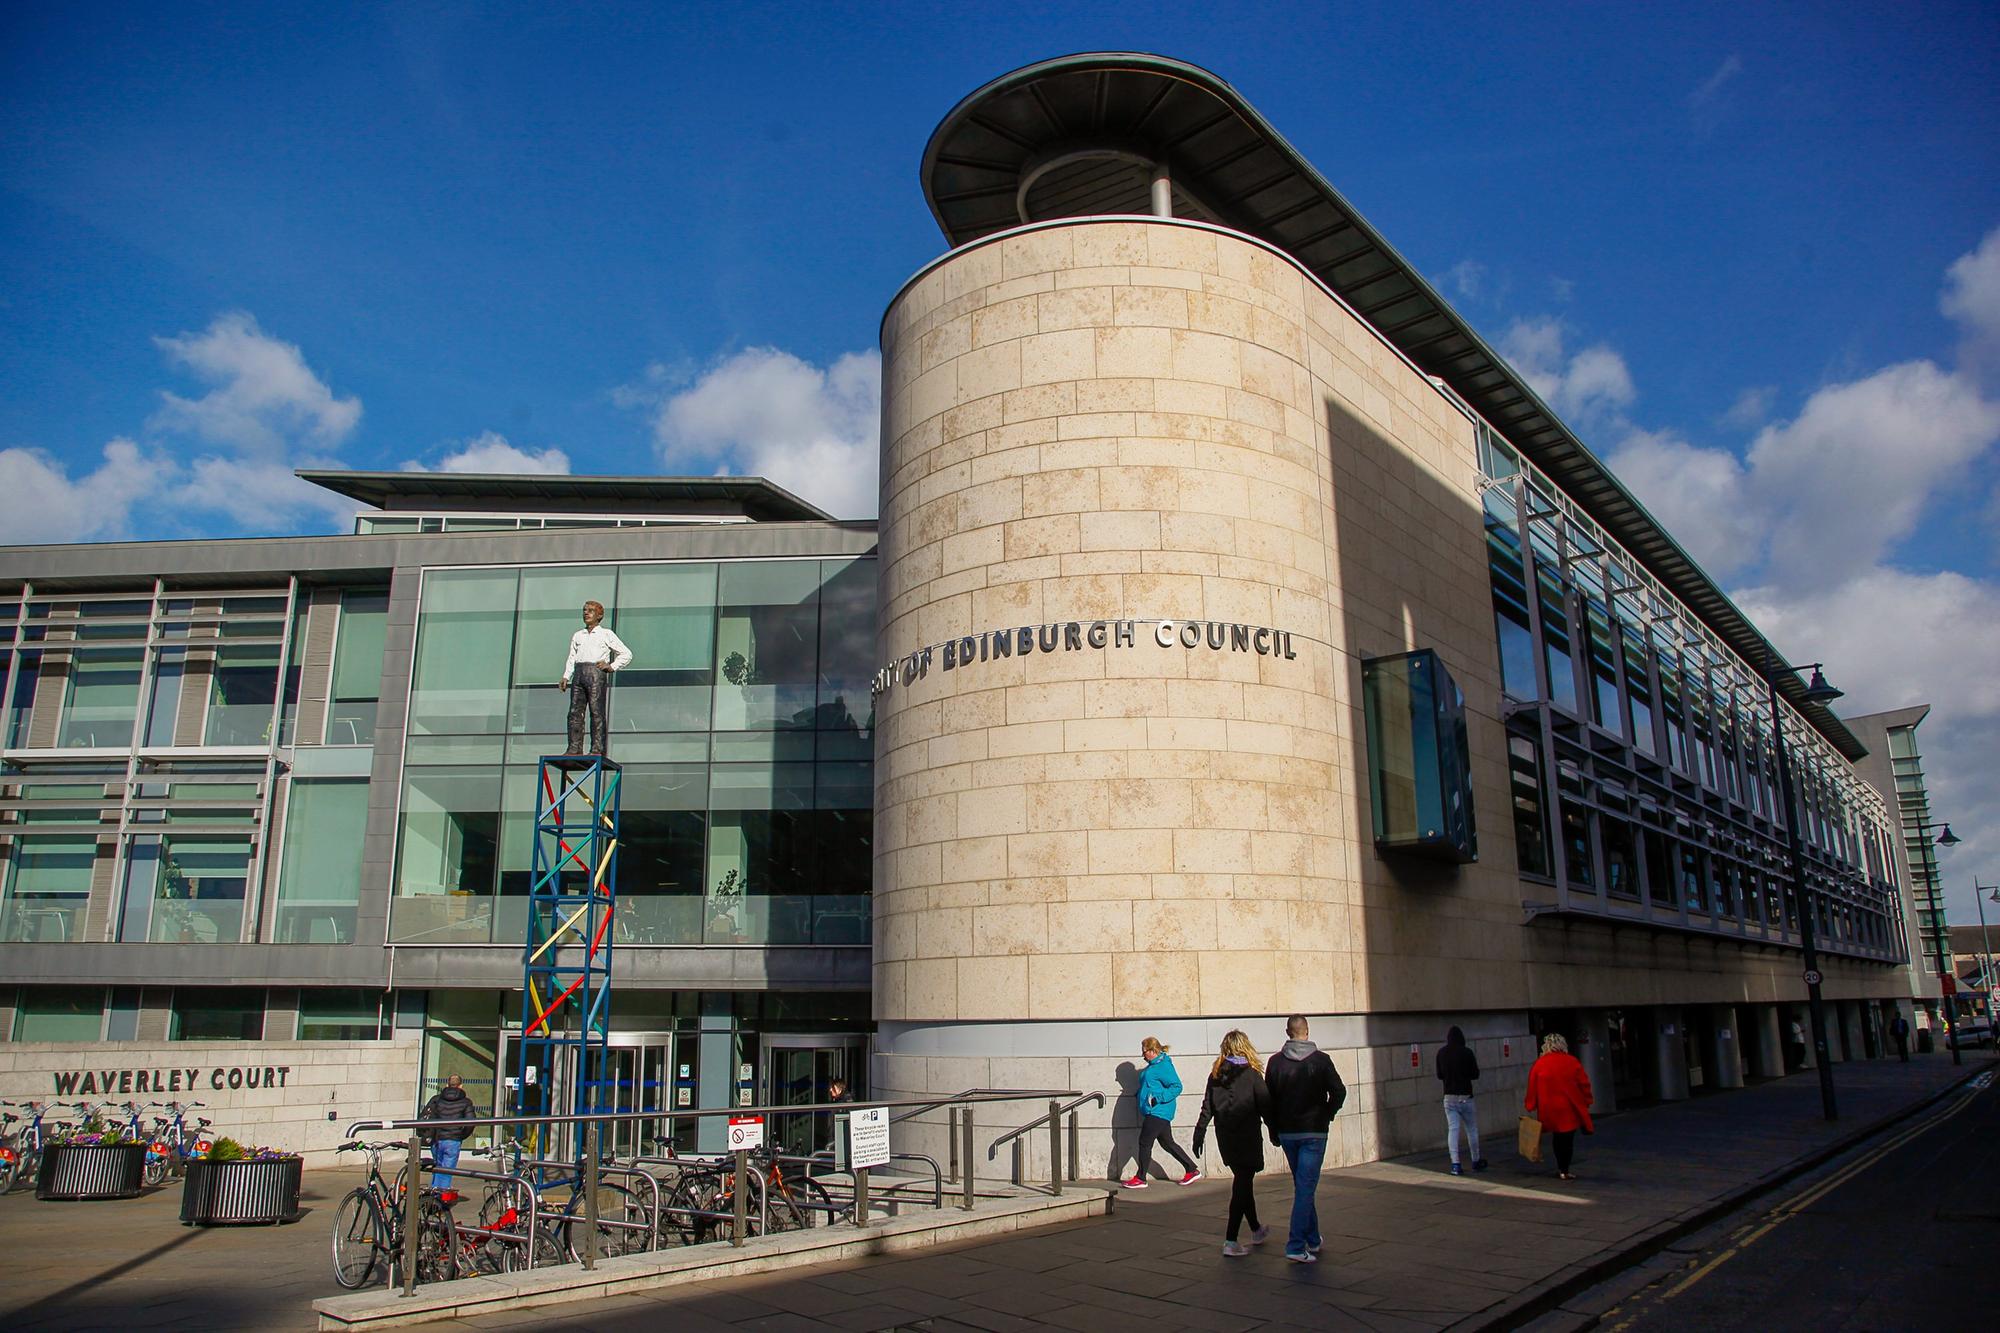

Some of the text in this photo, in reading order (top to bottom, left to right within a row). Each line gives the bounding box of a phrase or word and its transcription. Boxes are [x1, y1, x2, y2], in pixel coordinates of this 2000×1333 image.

[908, 646, 932, 677] OF
[943, 620, 1135, 672] EDINBURGH
[1155, 620, 1297, 661] COUNCIL
[1806, 973, 1818, 982] 20
[54, 1066, 290, 1096] WAVERLEY COURT
